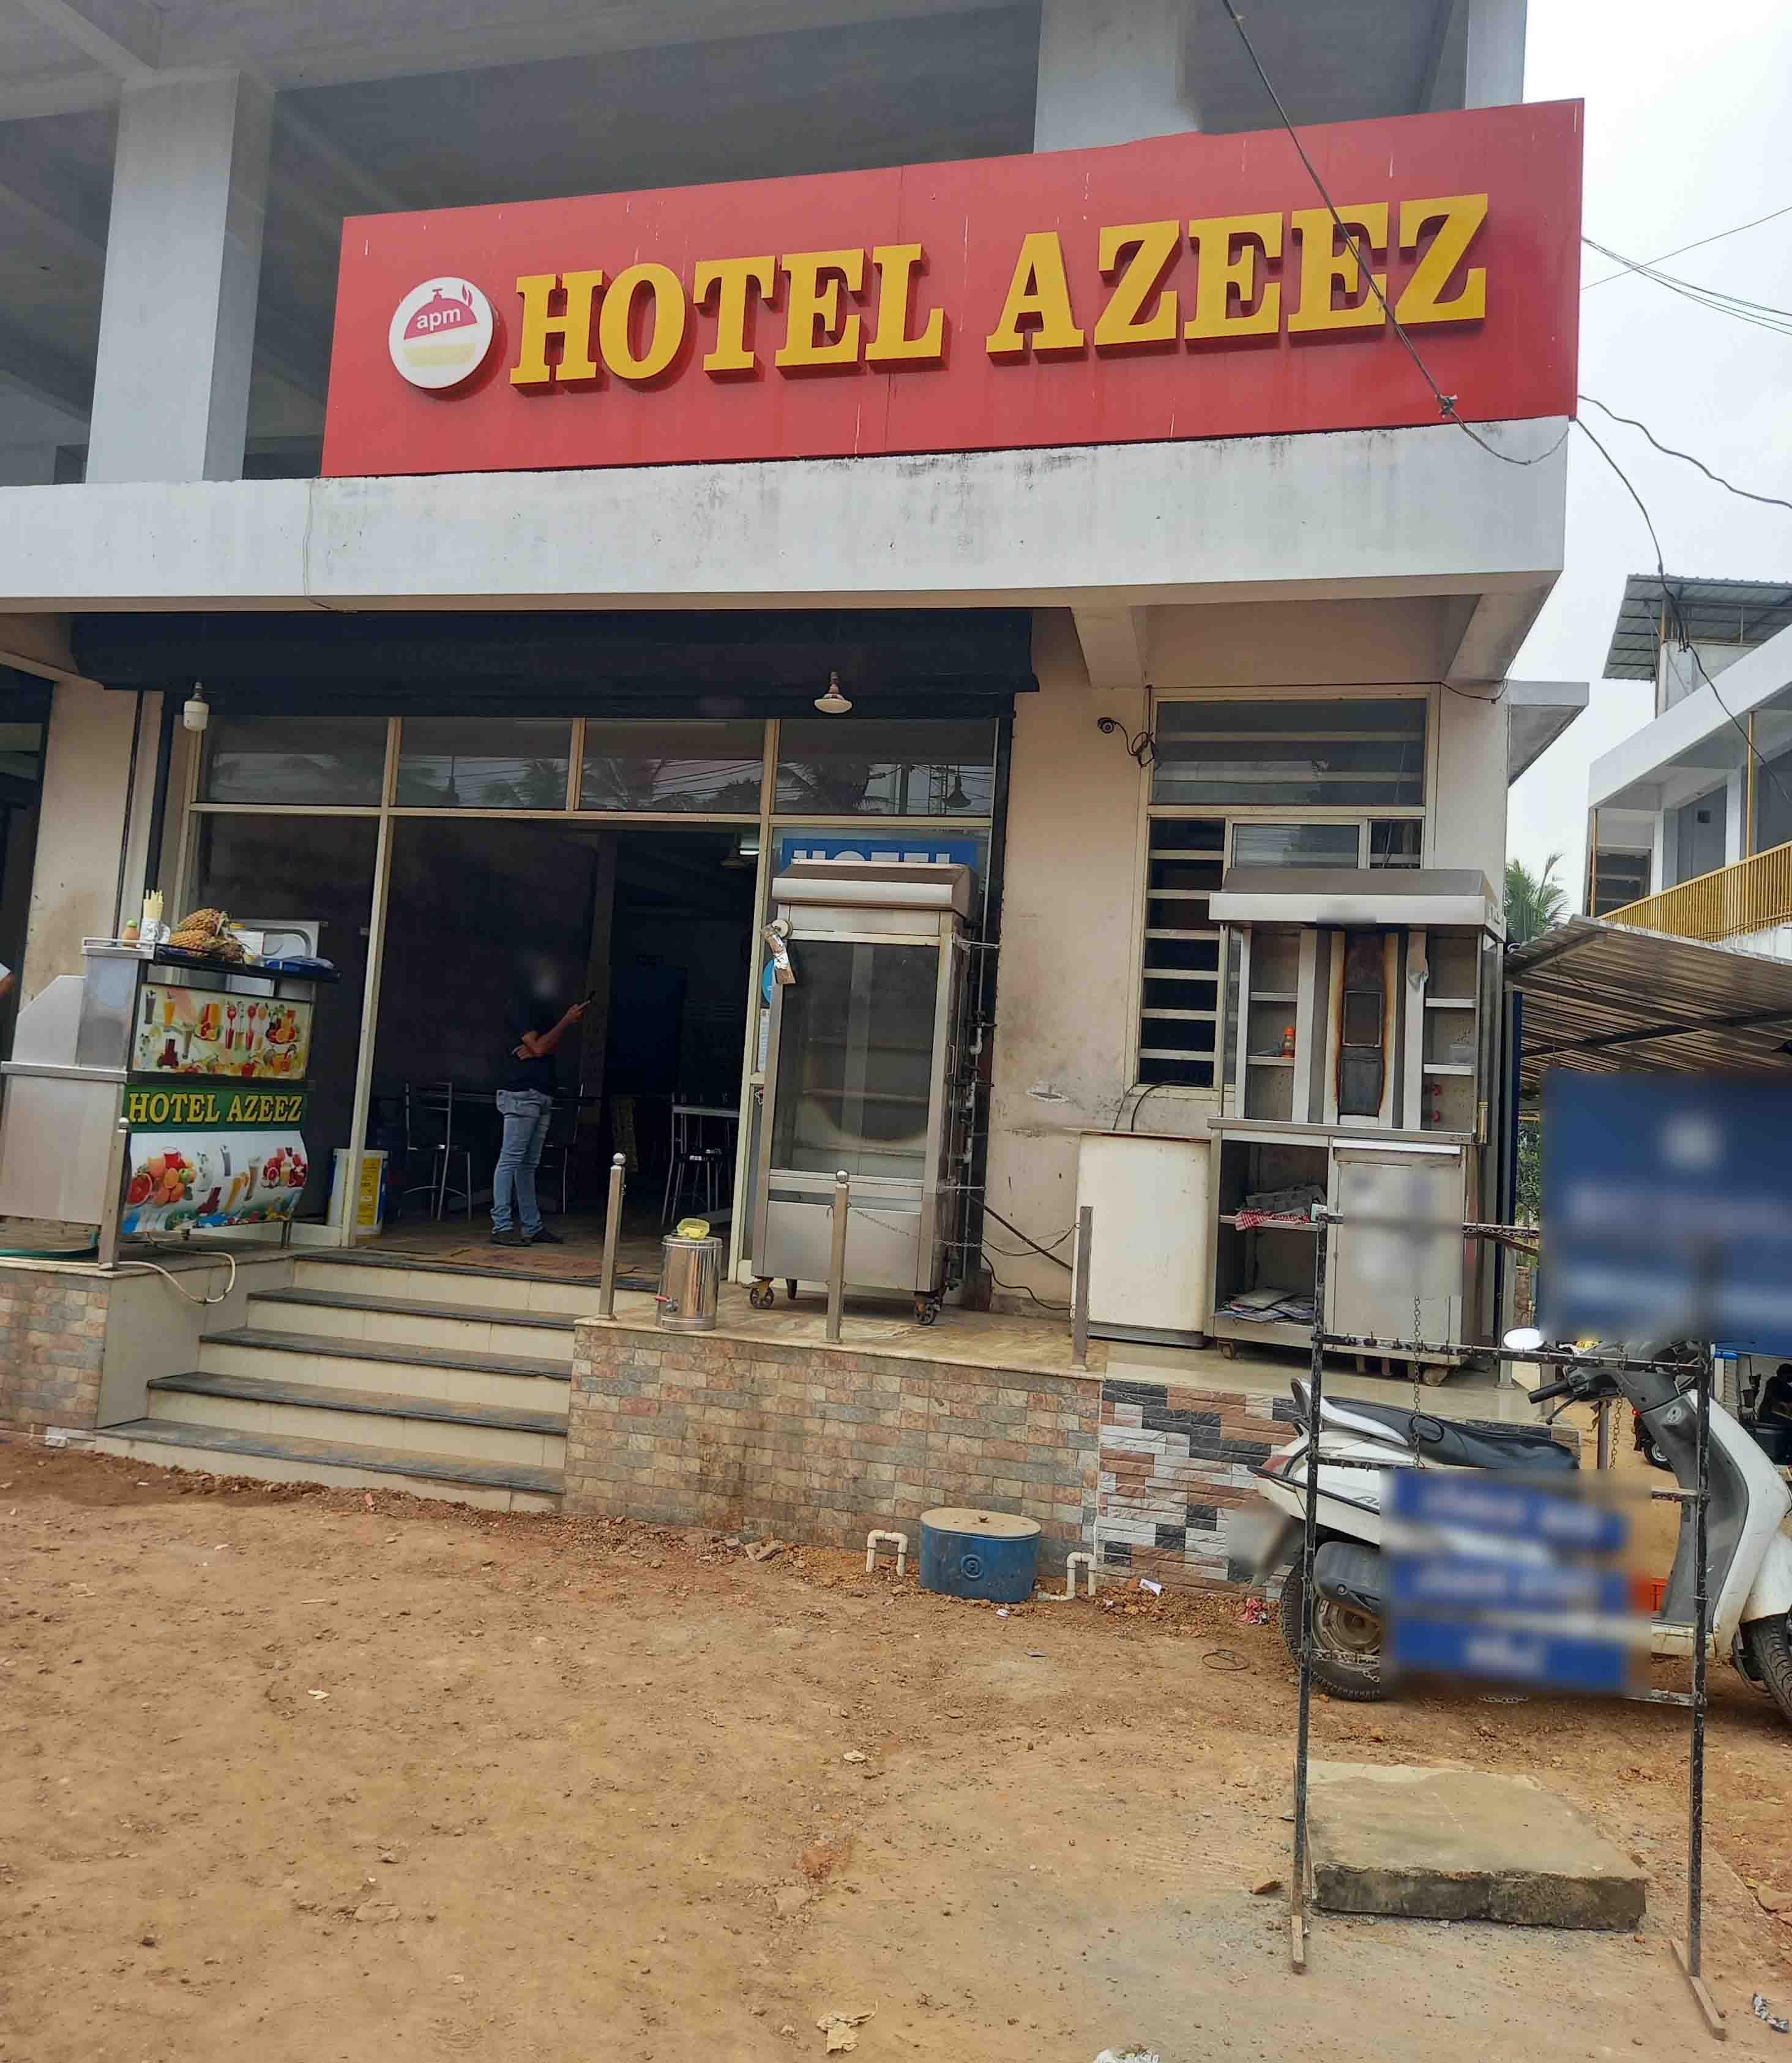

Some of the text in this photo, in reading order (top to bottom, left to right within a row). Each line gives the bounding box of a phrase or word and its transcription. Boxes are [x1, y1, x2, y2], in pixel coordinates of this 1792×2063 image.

[509, 193, 1488, 384] HOTEL AZEEZ
[416, 308, 461, 331] apm
[129, 1093, 302, 1123] HOTEL AZEEZ
